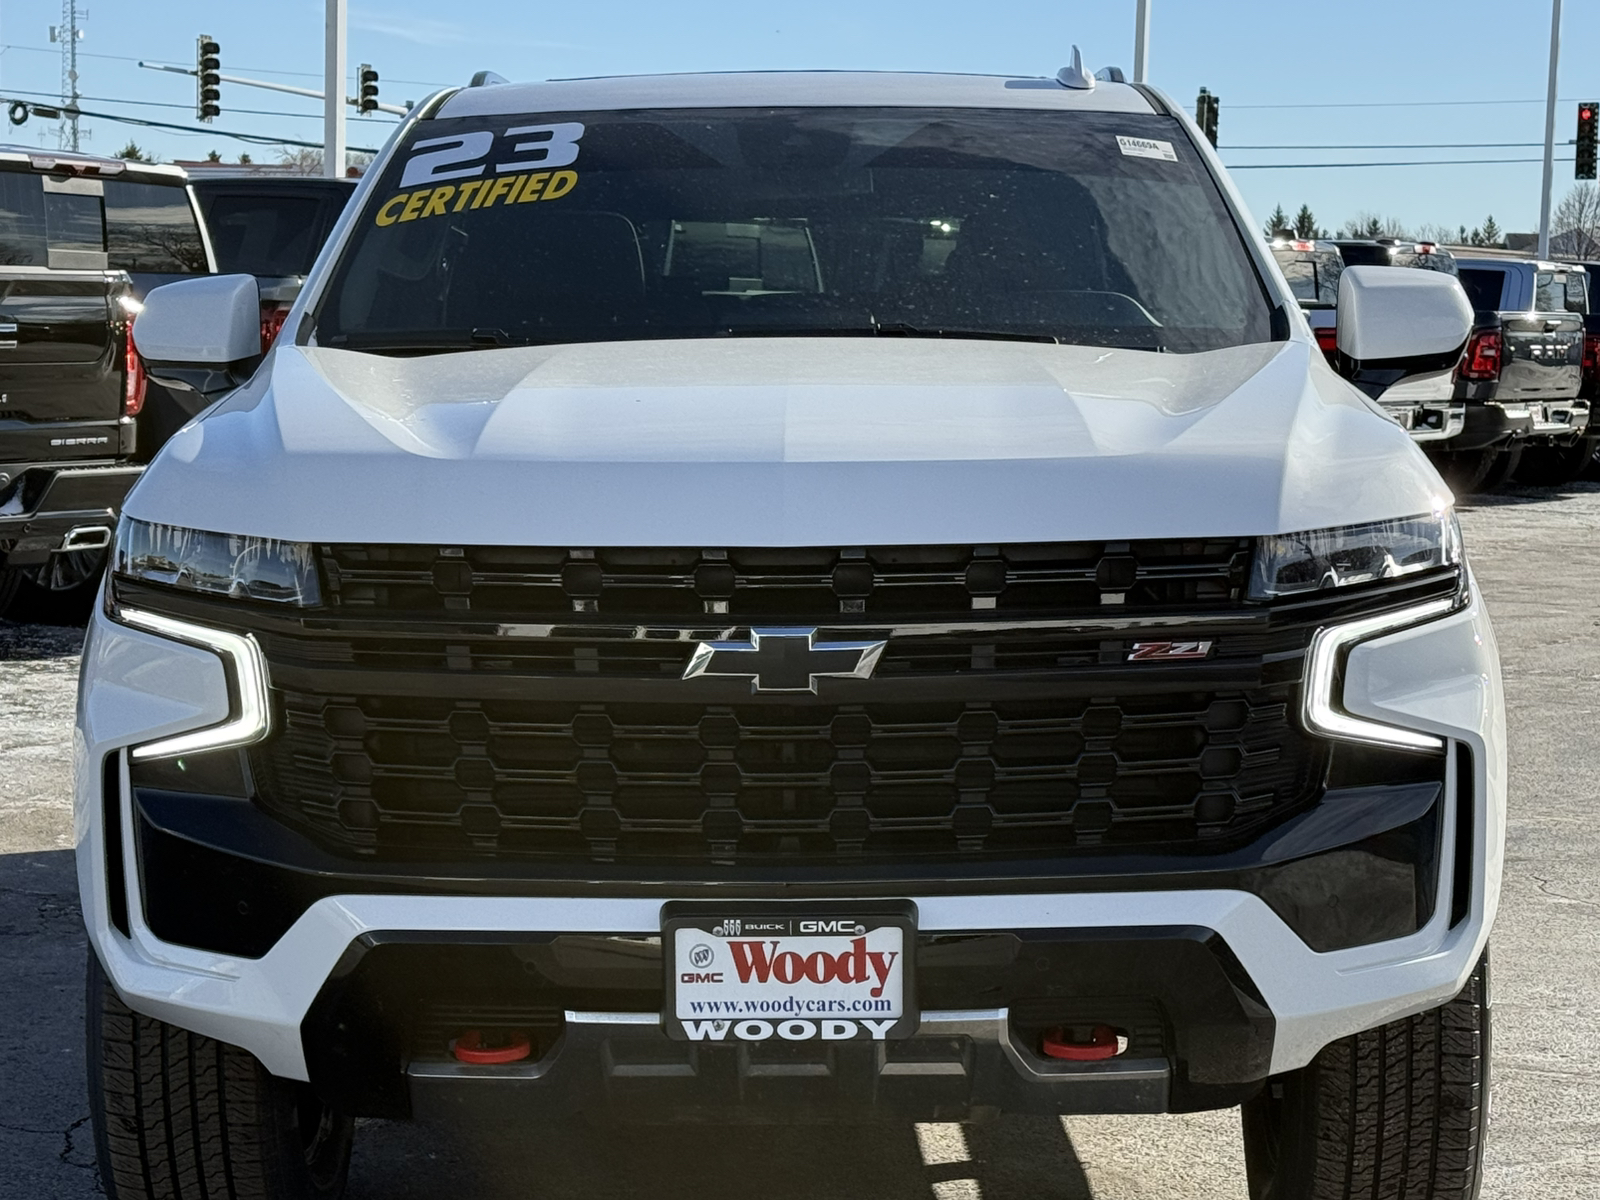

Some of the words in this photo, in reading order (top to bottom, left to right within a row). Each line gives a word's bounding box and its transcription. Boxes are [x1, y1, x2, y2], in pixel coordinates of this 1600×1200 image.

[399, 122, 585, 188] 23
[375, 170, 578, 227] CERTIFIED
[50, 437, 108, 446] SIERRA
[1127, 641, 1212, 660] Z71
[800, 920, 855, 933] GMC
[727, 937, 898, 997] Woody
[681, 972, 723, 983] GMC
[690, 996, 891, 1016] www.woodycars.com
[681, 1019, 898, 1040] WOODY
